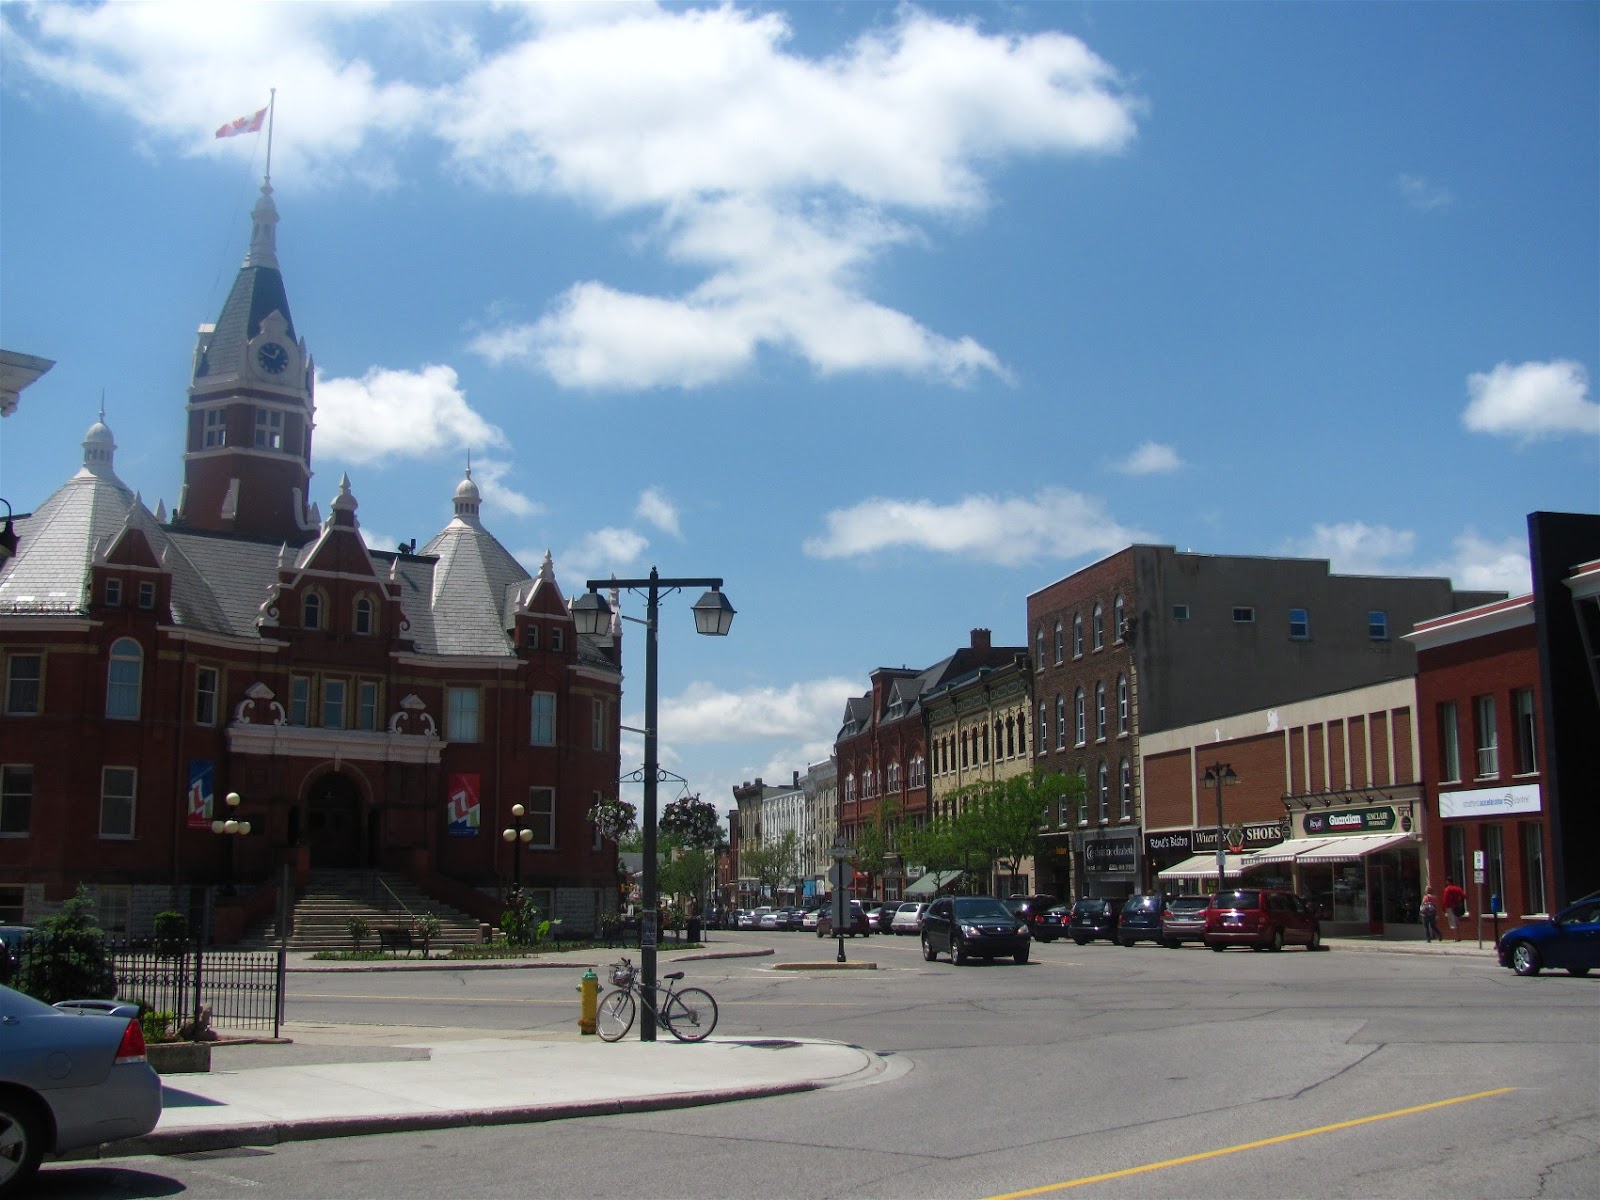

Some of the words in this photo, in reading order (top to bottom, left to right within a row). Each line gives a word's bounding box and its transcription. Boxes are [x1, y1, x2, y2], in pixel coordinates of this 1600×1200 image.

[1328, 814, 1361, 826] Guardian
[1365, 812, 1388, 821] SINCLAIR
[1195, 831, 1227, 844] Wuert's
[1246, 826, 1281, 841] SHOES
[1169, 834, 1188, 847] Bistro
